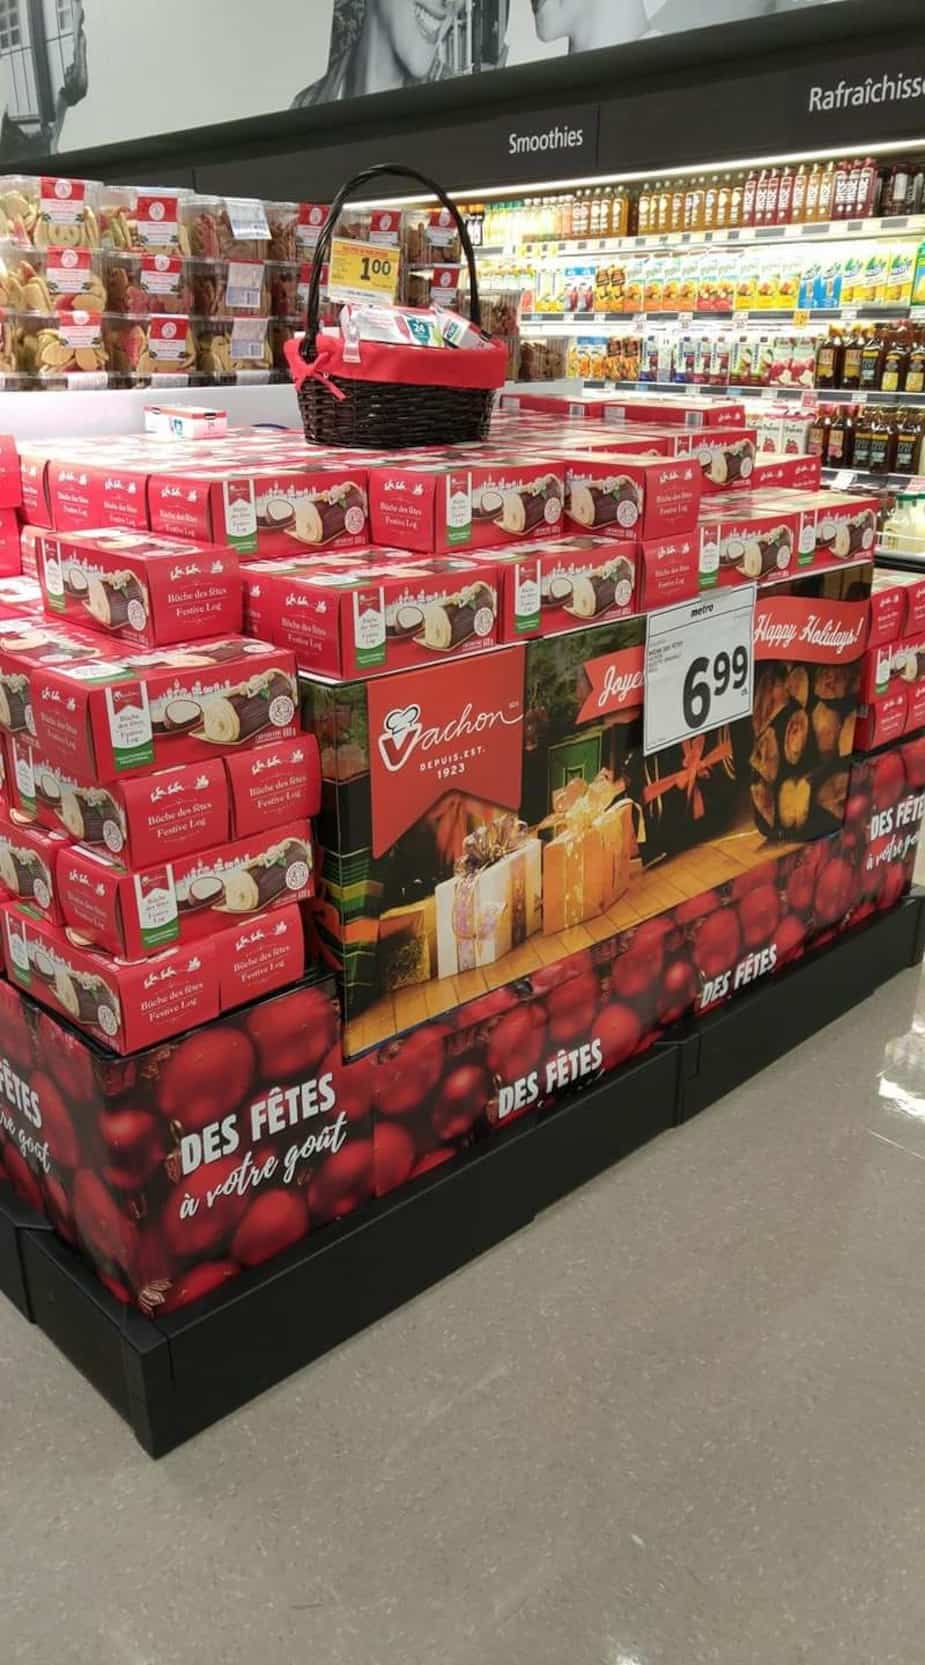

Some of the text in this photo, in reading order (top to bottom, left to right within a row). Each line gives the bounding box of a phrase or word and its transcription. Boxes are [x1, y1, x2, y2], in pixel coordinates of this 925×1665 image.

[509, 125, 583, 154] Smoothies
[194, 589, 208, 600] des
[206, 602, 222, 612] Log
[691, 603, 714, 618] metro
[752, 612, 797, 648] Happy
[799, 615, 864, 655] Holidays!
[378, 703, 524, 772] Vachon
[437, 763, 465, 779] 1923
[275, 780, 289, 789] des
[286, 790, 301, 800] Log
[177, 808, 191, 817] des
[189, 817, 206, 828] Log
[870, 807, 894, 840] DES
[259, 952, 272, 962] des
[269, 960, 285, 971] Log
[699, 944, 777, 1009] DES FÊTES
[169, 991, 183, 1001] des
[181, 998, 197, 1009] Log
[499, 1038, 603, 1118] DES FÊTES
[181, 1073, 336, 1176] DES FÊTES
[180, 1111, 347, 1219] à votre goût
